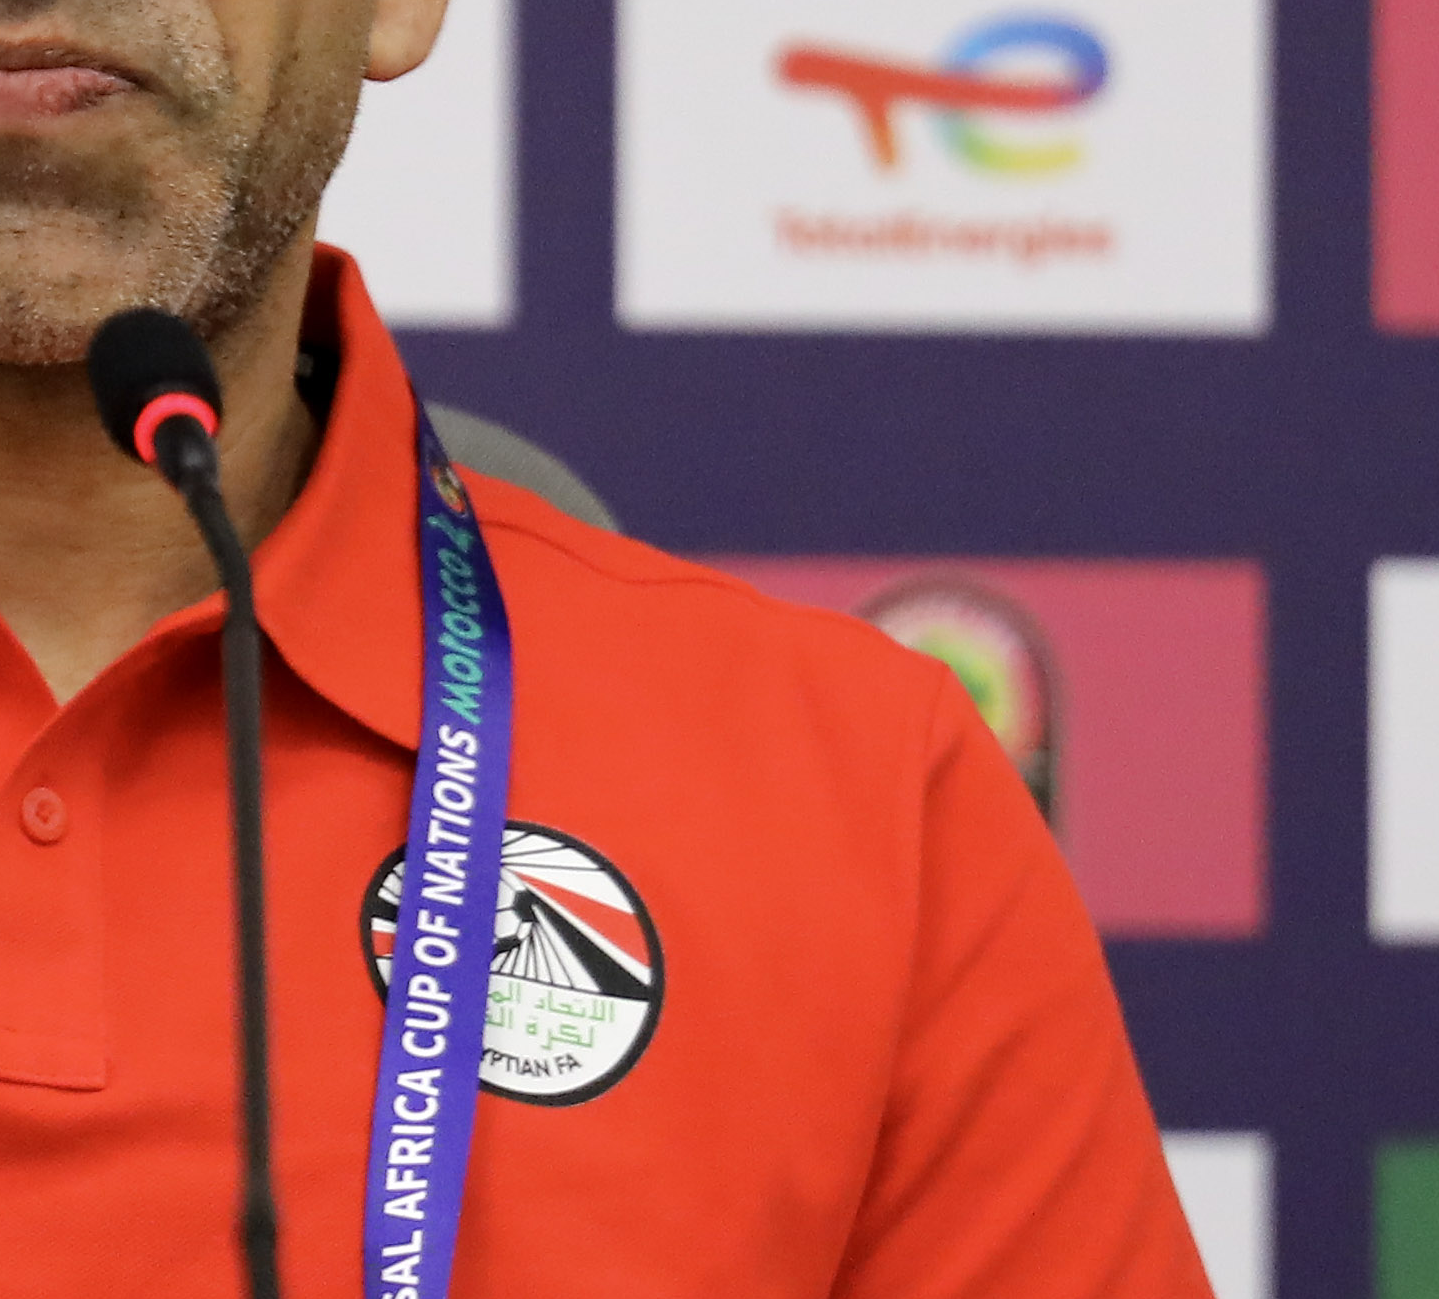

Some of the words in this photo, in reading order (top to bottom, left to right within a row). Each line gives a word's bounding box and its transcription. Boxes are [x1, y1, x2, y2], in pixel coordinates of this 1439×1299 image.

[421, 724, 479, 906] NATIONS
[413, 909, 461, 968] OF
[402, 973, 452, 1058] CUP
[553, 1052, 583, 1076] FA
[383, 1068, 443, 1220] AFRICA
